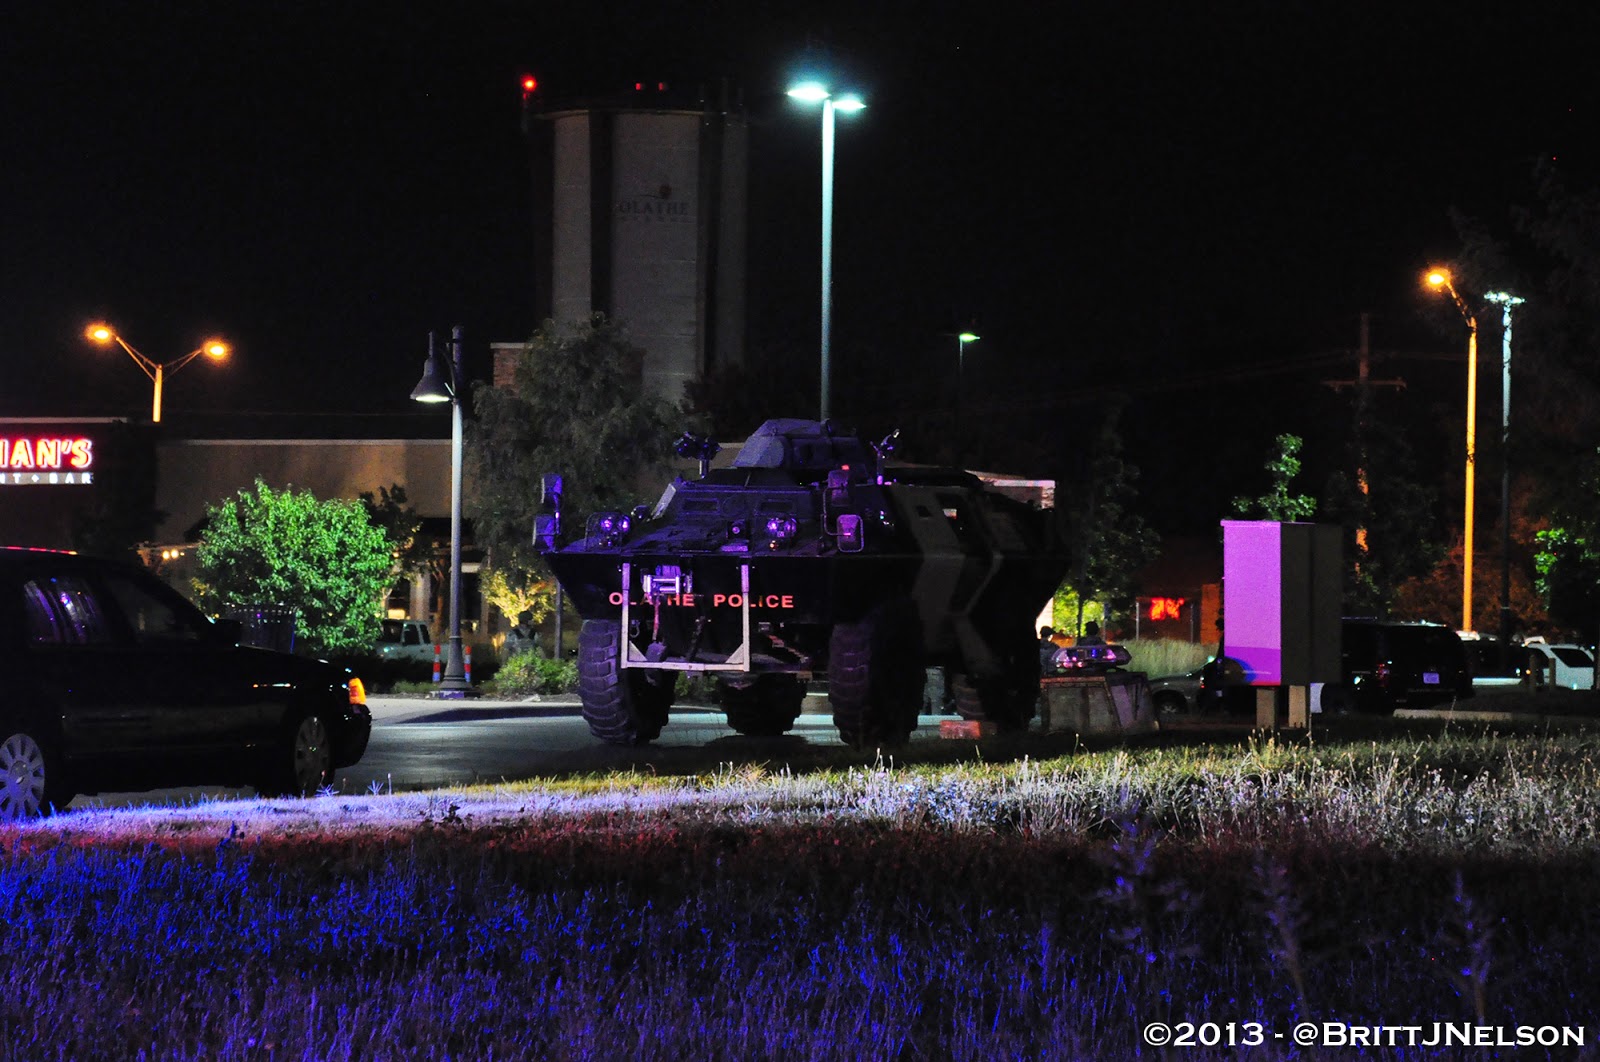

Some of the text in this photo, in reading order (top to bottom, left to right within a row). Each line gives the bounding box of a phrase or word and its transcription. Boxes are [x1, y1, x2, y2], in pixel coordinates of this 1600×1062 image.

[619, 201, 689, 216] OLATHE
[49, 473, 92, 484] BAR
[608, 591, 696, 607] OAHE
